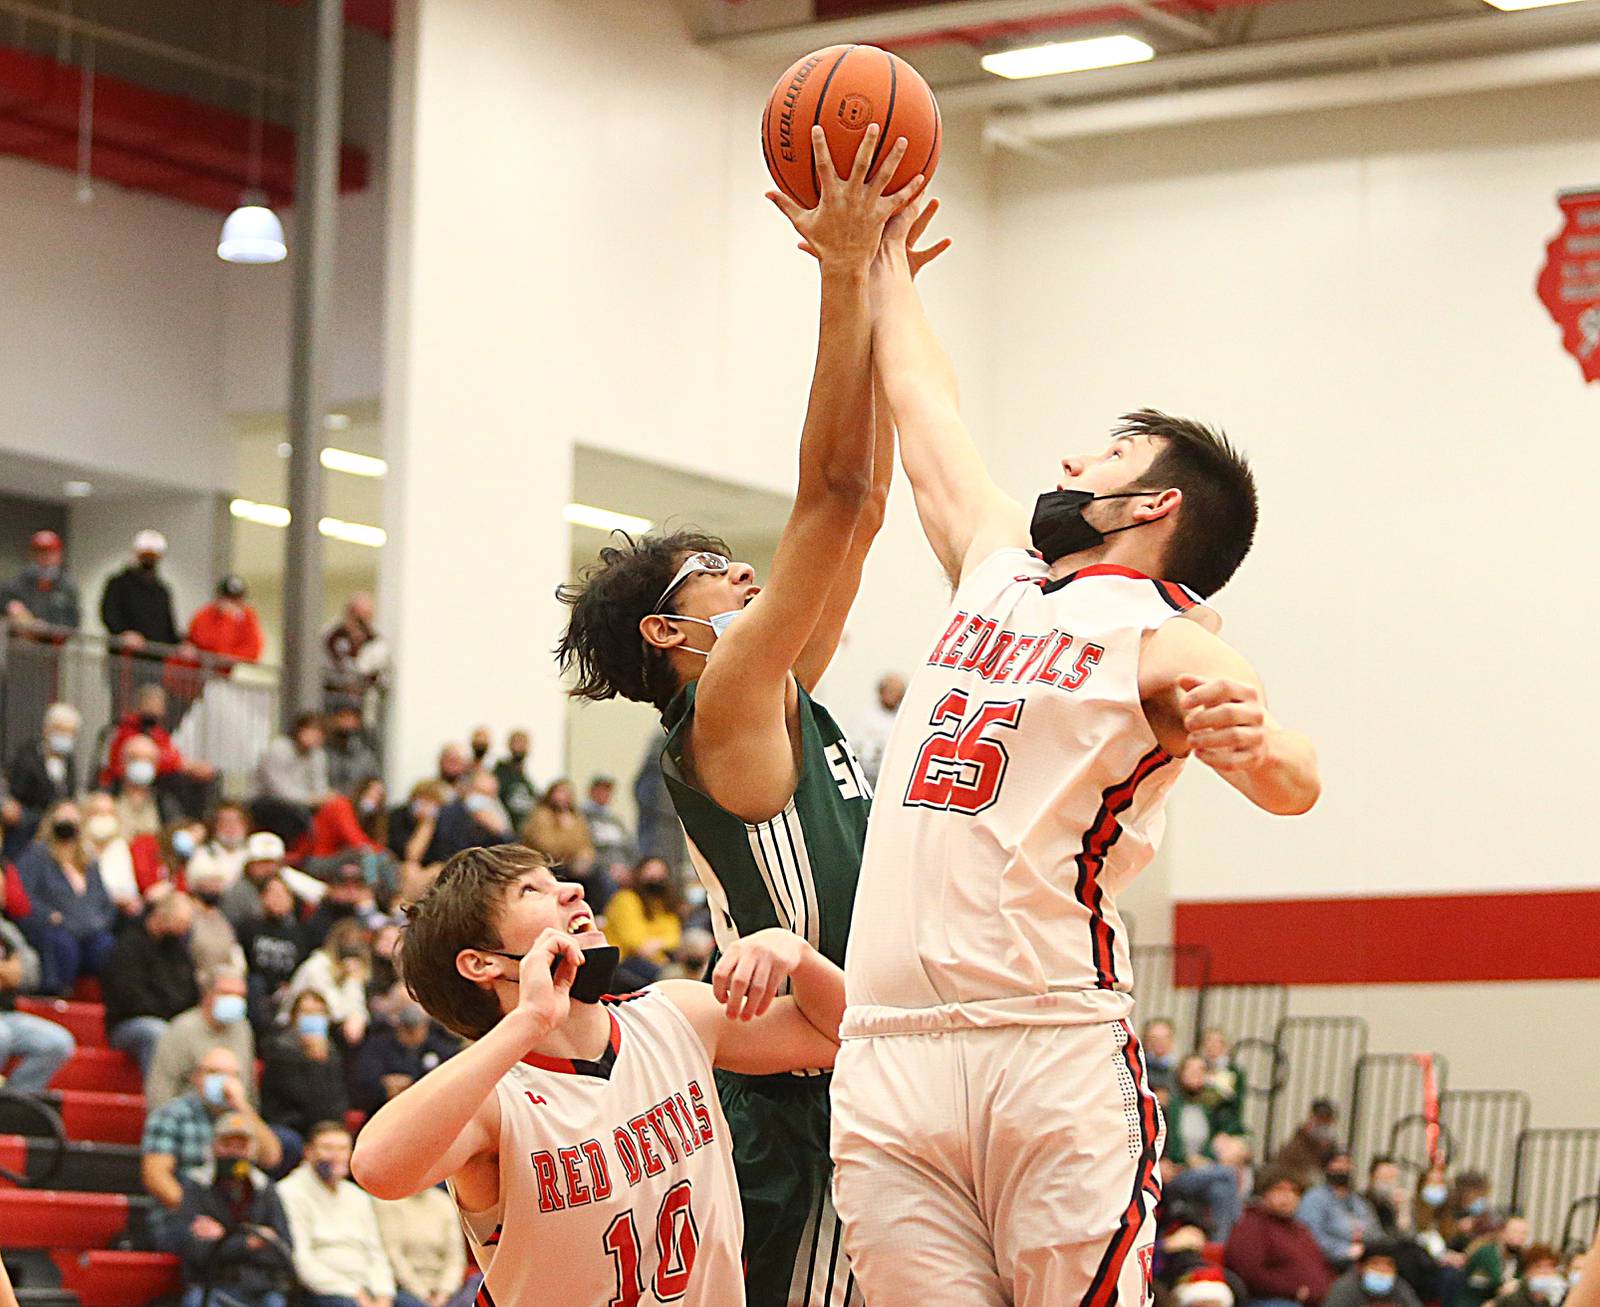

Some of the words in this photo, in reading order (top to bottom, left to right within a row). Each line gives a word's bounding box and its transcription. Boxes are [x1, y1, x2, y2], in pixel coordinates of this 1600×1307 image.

[780, 56, 822, 164] EVOLUTION
[926, 610, 999, 673] RED
[975, 628, 1106, 693] DEVILS
[902, 687, 1026, 816] 25
[531, 1138, 613, 1214] RED
[613, 1080, 715, 1188] DEVILS
[602, 1178, 700, 1307] 10
